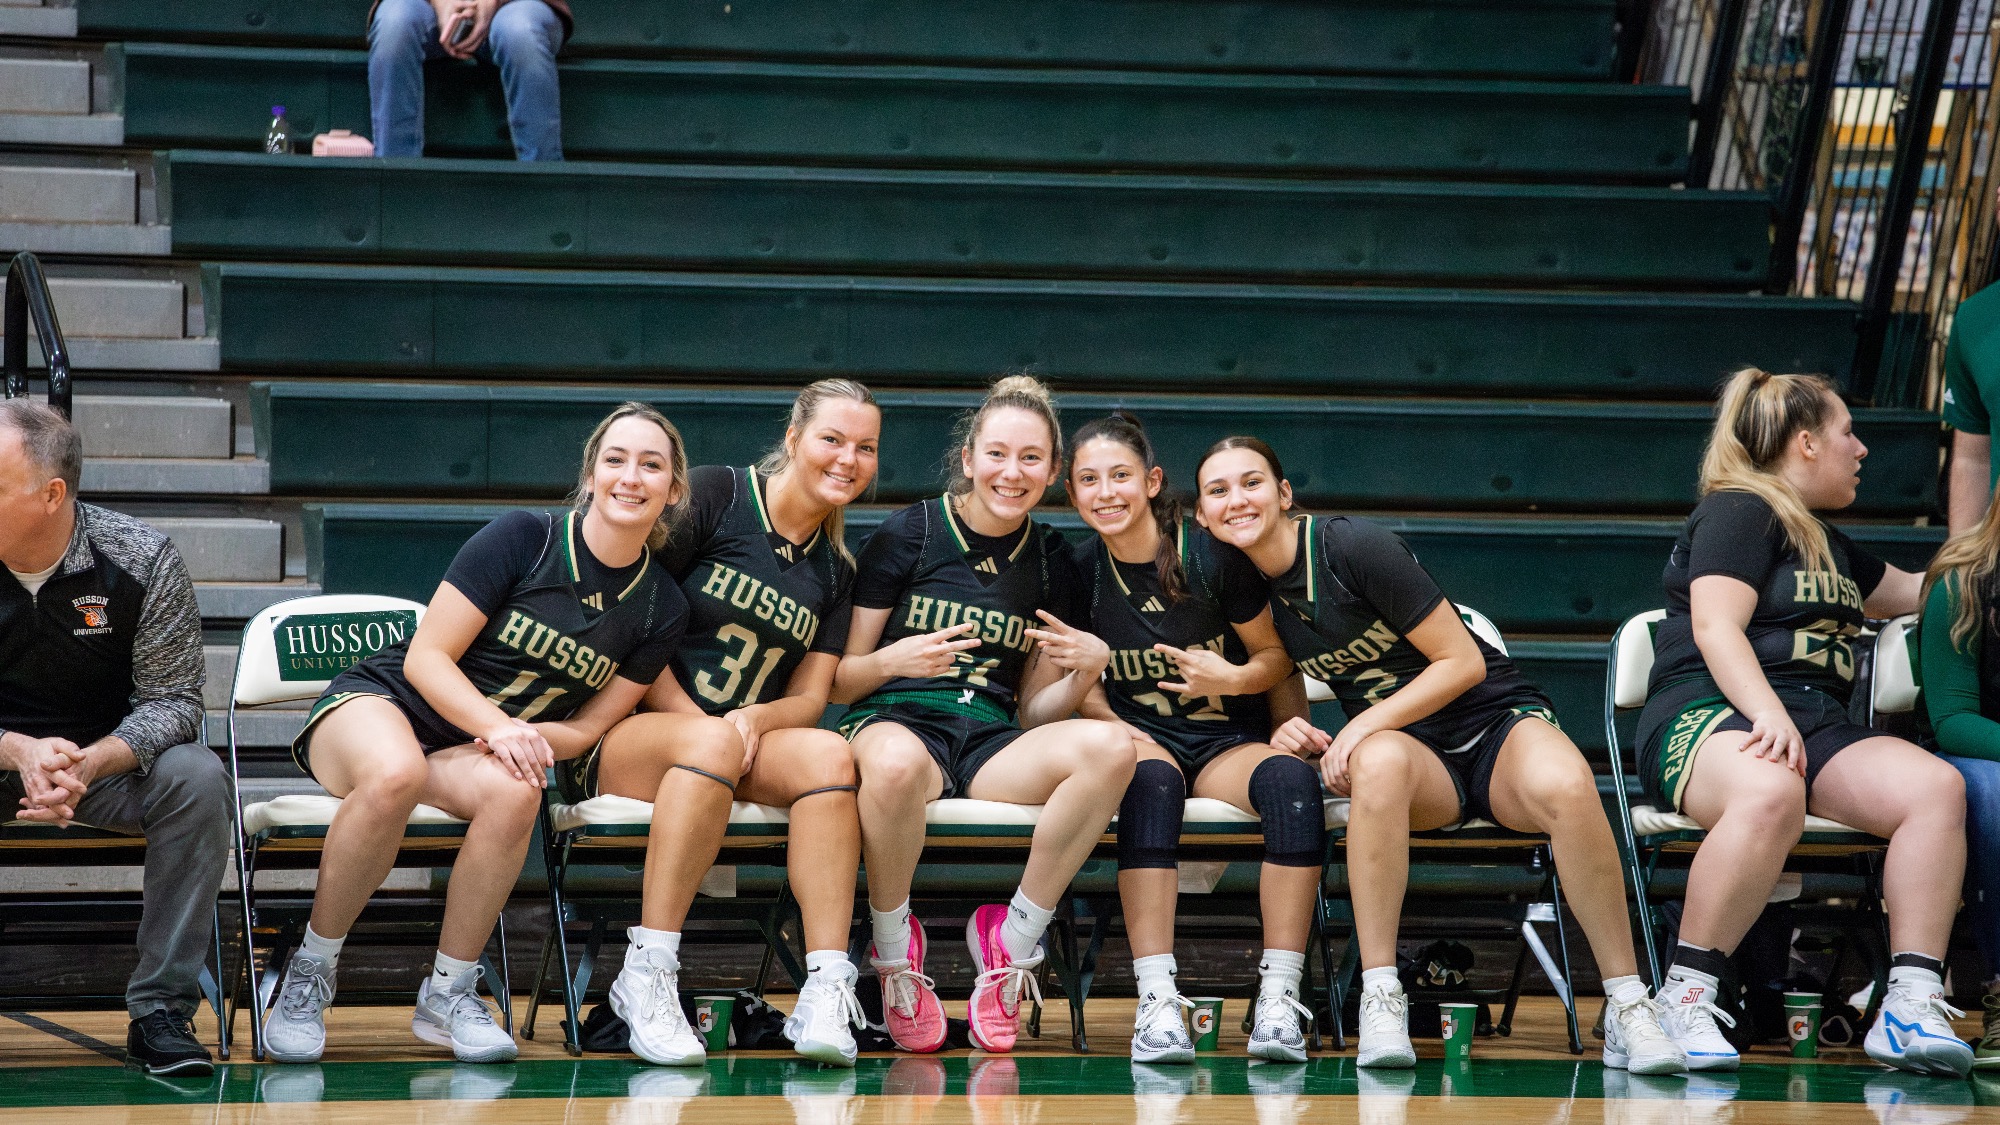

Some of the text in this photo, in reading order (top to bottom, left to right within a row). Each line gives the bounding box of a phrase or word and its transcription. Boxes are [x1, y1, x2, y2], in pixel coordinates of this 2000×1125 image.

[71, 595, 109, 607] HUSSON
[701, 562, 820, 651] HUSSON
[73, 627, 113, 636] UNIVERSITY
[285, 620, 405, 655] HUSSON
[905, 594, 1038, 654] HUSSON
[694, 622, 787, 709] 31
[1108, 633, 1225, 681] HUSSN
[1296, 619, 1400, 681] USSON
[1664, 709, 1714, 782] EAGLES
[696, 1006, 713, 1033] G
[1192, 1008, 1214, 1034] G
[1788, 1015, 1809, 1041] G
